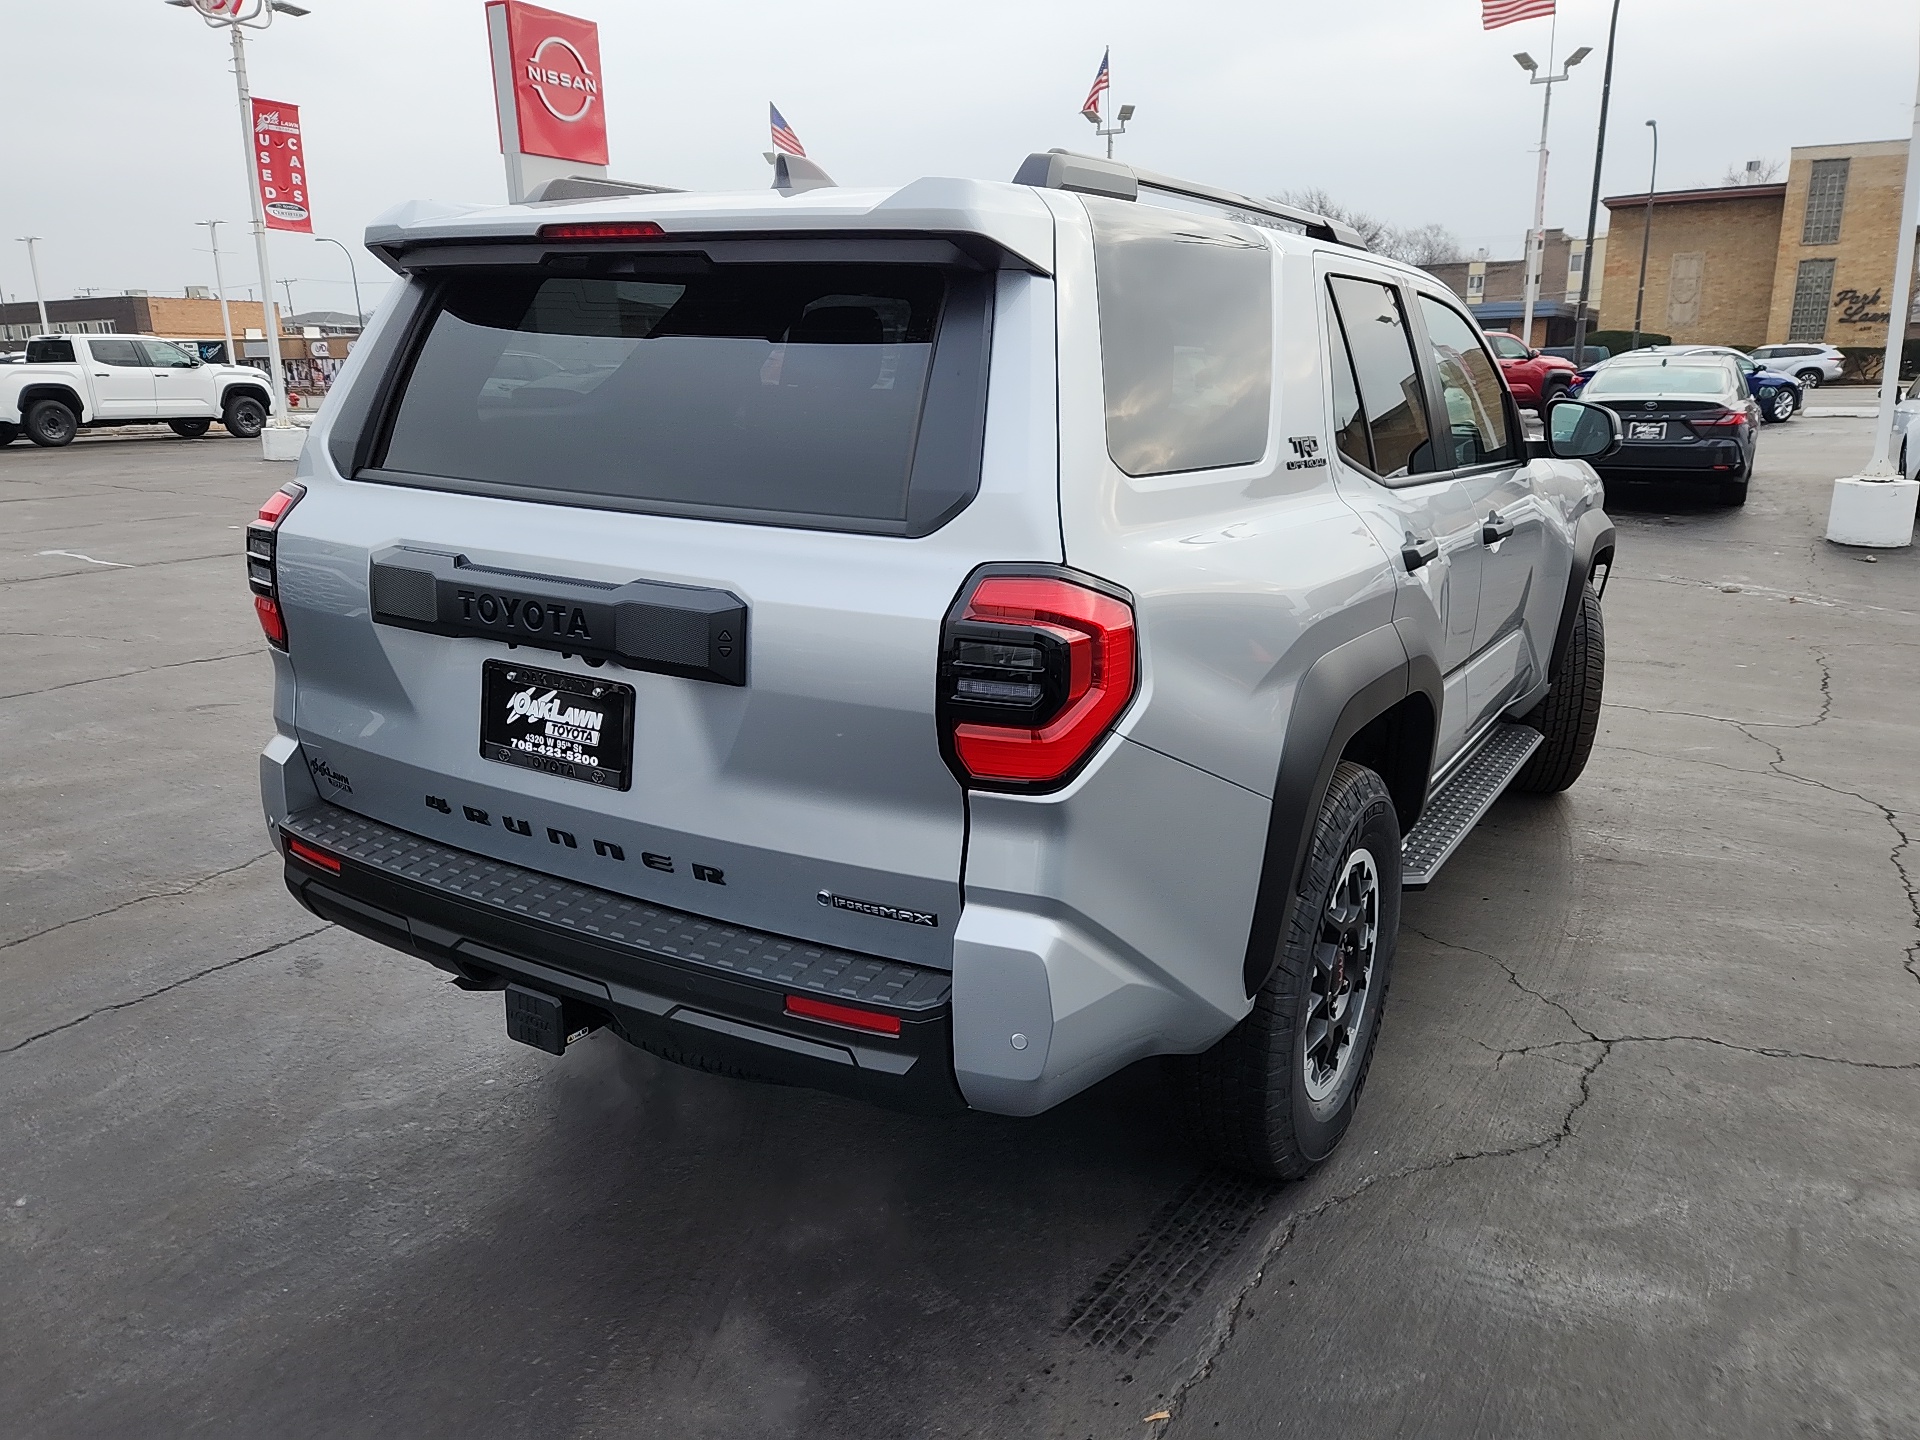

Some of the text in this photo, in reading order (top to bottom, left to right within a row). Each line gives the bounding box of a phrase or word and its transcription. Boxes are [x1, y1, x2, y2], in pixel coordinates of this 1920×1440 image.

[527, 65, 597, 94] NISSAN
[258, 134, 276, 199] USED
[287, 138, 303, 202] CARS
[1834, 287, 1882, 307] Park
[1288, 436, 1319, 459] TRD
[458, 589, 592, 641] TOYOTA
[525, 733, 544, 745] 4320
[546, 738, 554, 747] W
[573, 743, 583, 754] St
[551, 723, 594, 743] TOYOTA
[510, 738, 599, 767] 708-423-5200
[524, 753, 576, 777] TOYOTA
[425, 794, 727, 886] 4RUNNER
